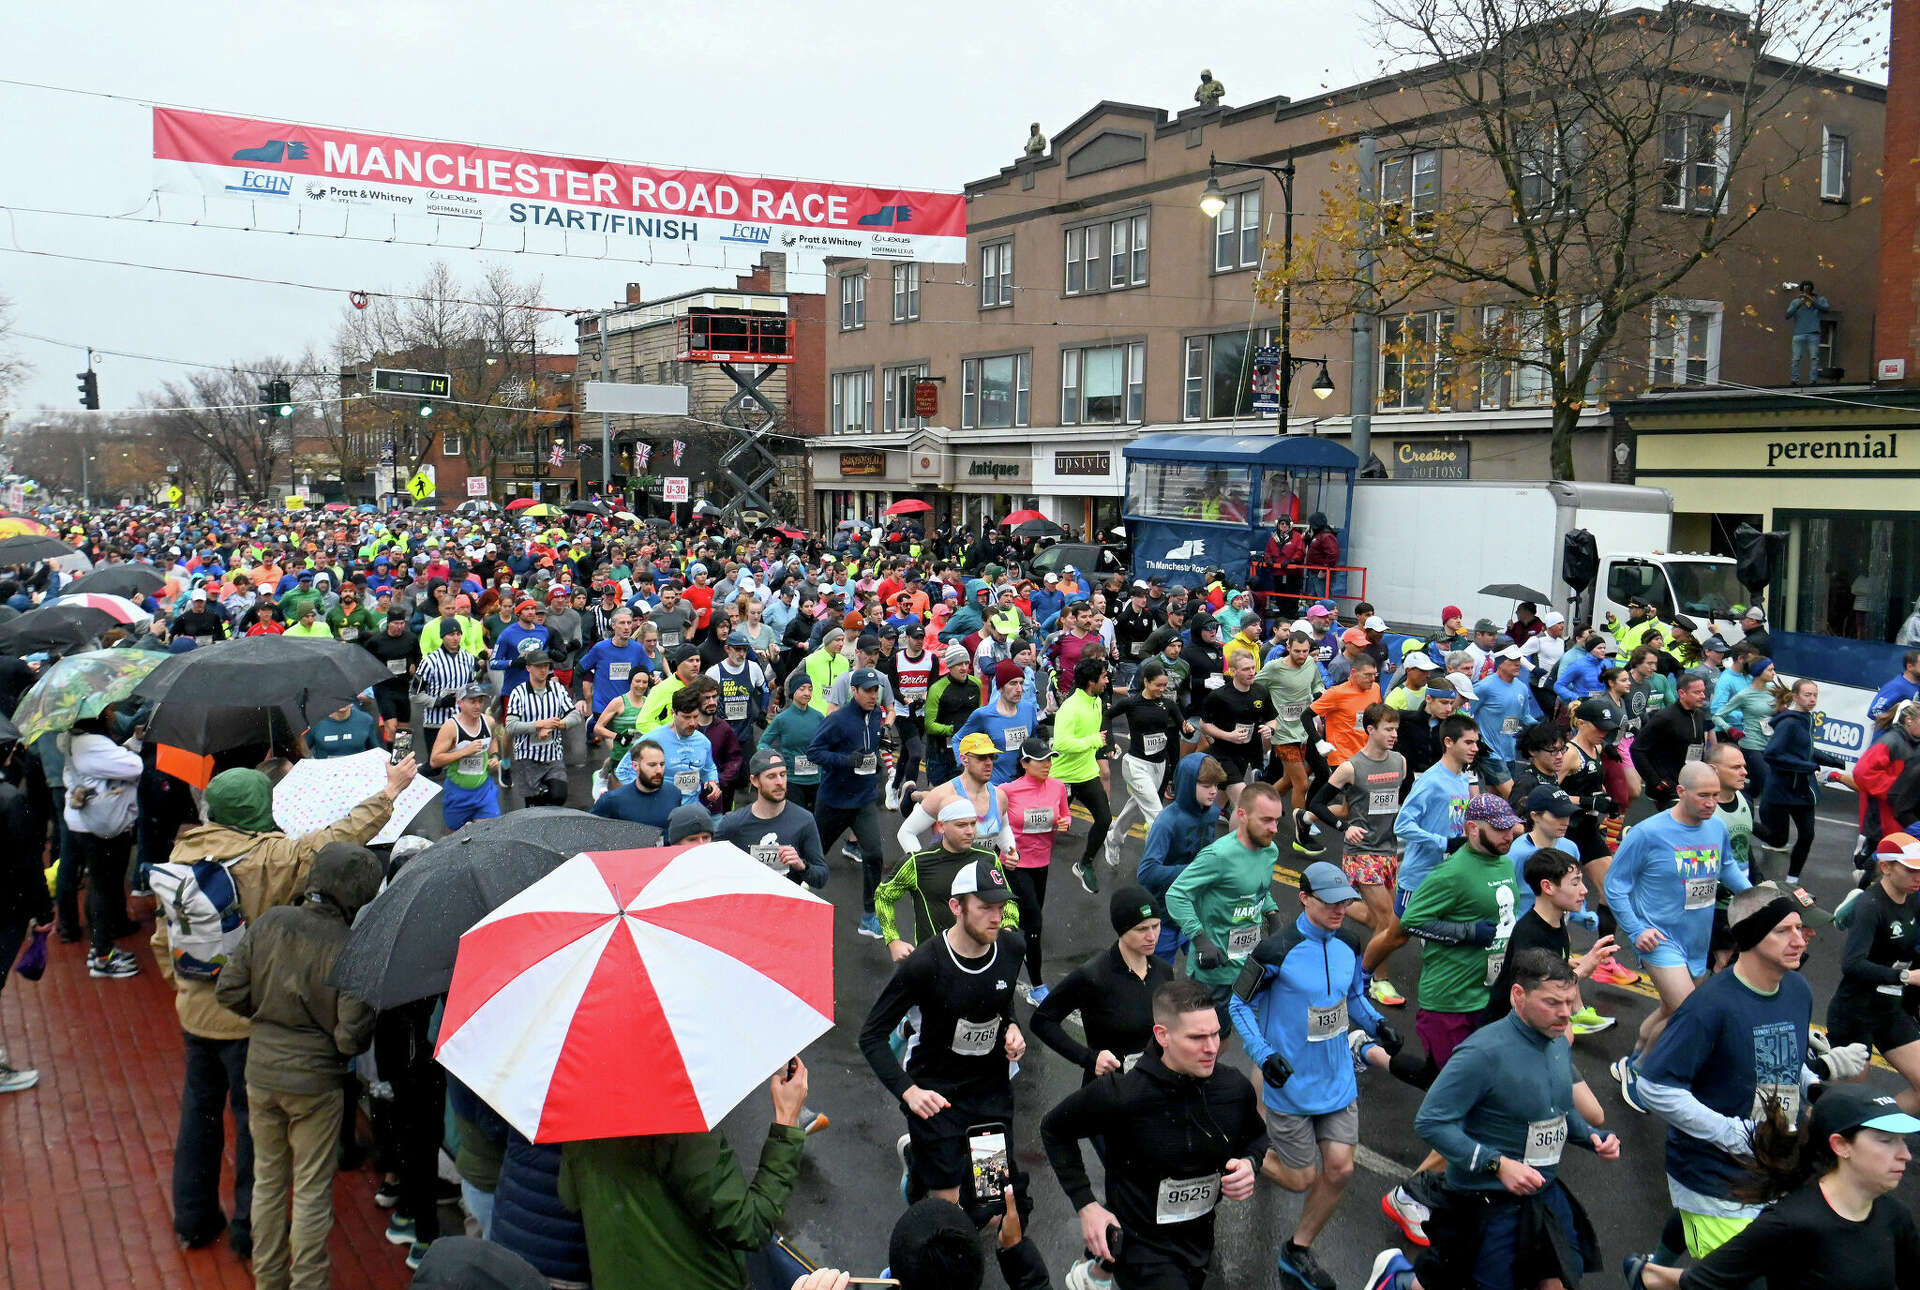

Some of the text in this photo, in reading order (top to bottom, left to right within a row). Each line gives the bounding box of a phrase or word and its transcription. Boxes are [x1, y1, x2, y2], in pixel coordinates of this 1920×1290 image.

[242, 170, 294, 191] ECHN
[323, 140, 848, 224] MANCHESTER ROAD RACE
[330, 186, 413, 204] Pratt & Whitney
[440, 194, 477, 203] LEXUS
[427, 204, 482, 216] HOFFMAN LEXUS
[509, 202, 698, 241] START/FINISH
[732, 223, 772, 240] ECHN
[799, 235, 862, 248] Pratt & Whitney
[1399, 443, 1456, 464] Creative
[1766, 433, 1898, 467] perennial
[968, 460, 1019, 480] Antiques
[1057, 453, 1108, 473] upstyle
[1412, 466, 1463, 478] NOTIONS
[666, 485, 686, 494] U-30
[1156, 561, 1191, 572] Manchester
[900, 674, 928, 685] Berlin
[1822, 722, 1860, 747] 1080
[678, 775, 696, 784] 7058
[1374, 794, 1395, 804] 2687
[1030, 815, 1048, 824] 1185
[990, 869, 1004, 885] C
[1692, 884, 1715, 897] 2238
[1318, 1009, 1341, 1026] 1337
[963, 1027, 995, 1042] 4768
[1535, 1126, 1565, 1147] 3648
[1168, 1186, 1210, 1203] 9525
